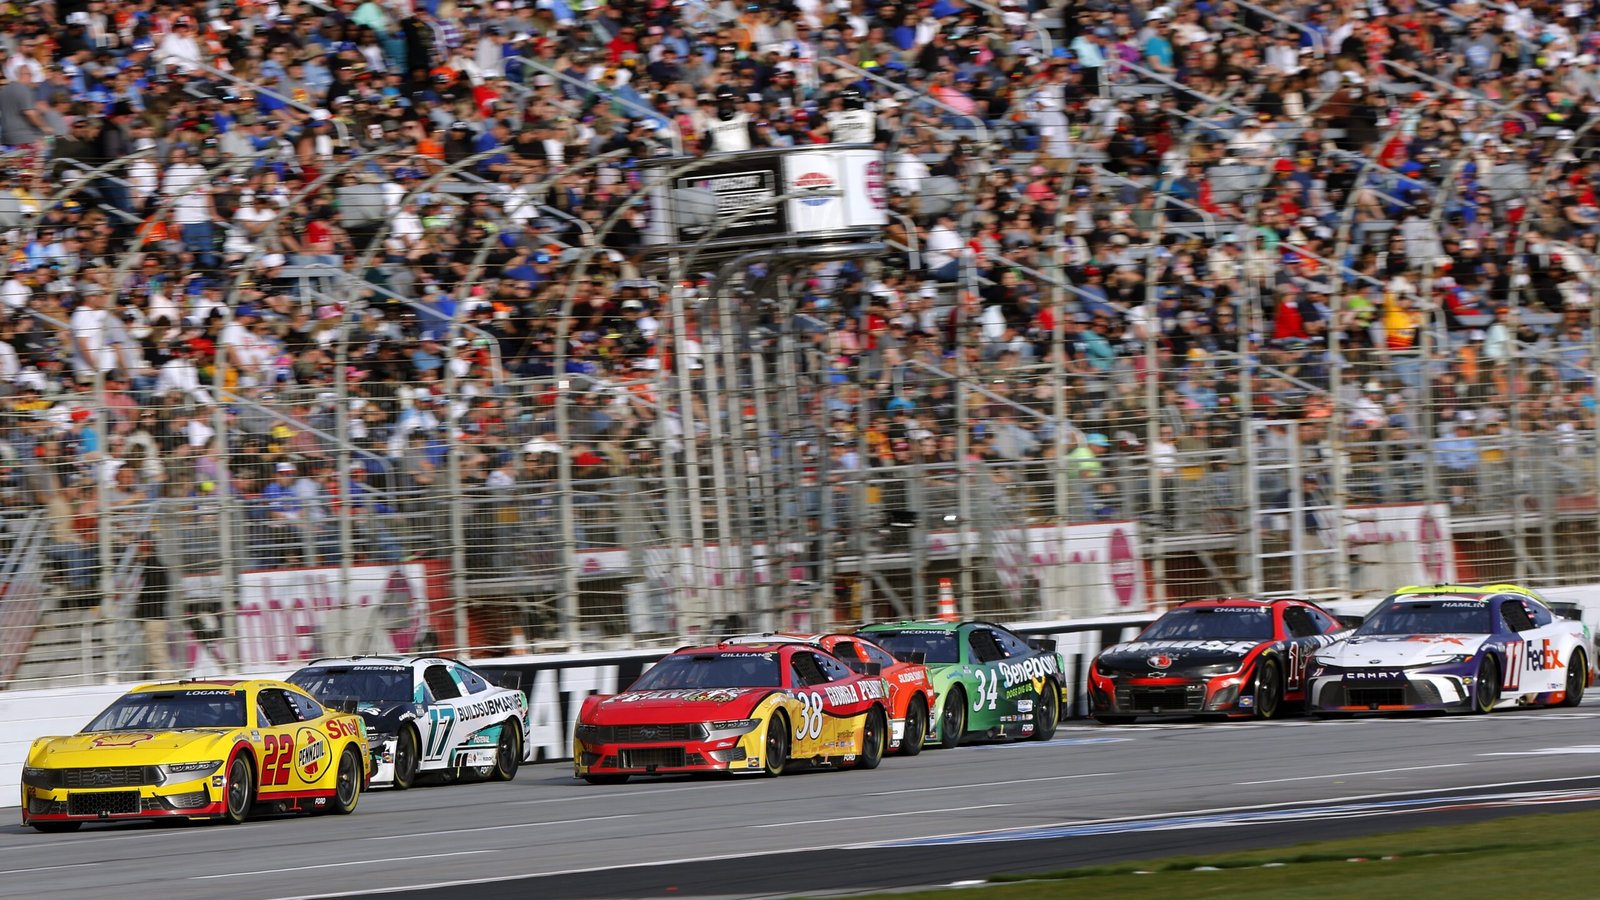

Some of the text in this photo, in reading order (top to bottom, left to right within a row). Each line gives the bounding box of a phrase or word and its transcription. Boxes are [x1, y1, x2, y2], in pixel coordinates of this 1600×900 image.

[1288, 641, 1299, 690] 1
[1503, 640, 1524, 690] 11
[1526, 639, 1565, 671] FedEx
[973, 669, 998, 712] 34
[326, 718, 360, 740] Shell
[424, 704, 457, 762] 17
[796, 691, 823, 740] 38
[260, 733, 294, 787] 22
[298, 740, 326, 768] PENNZOIL
[314, 797, 327, 805] FORD
